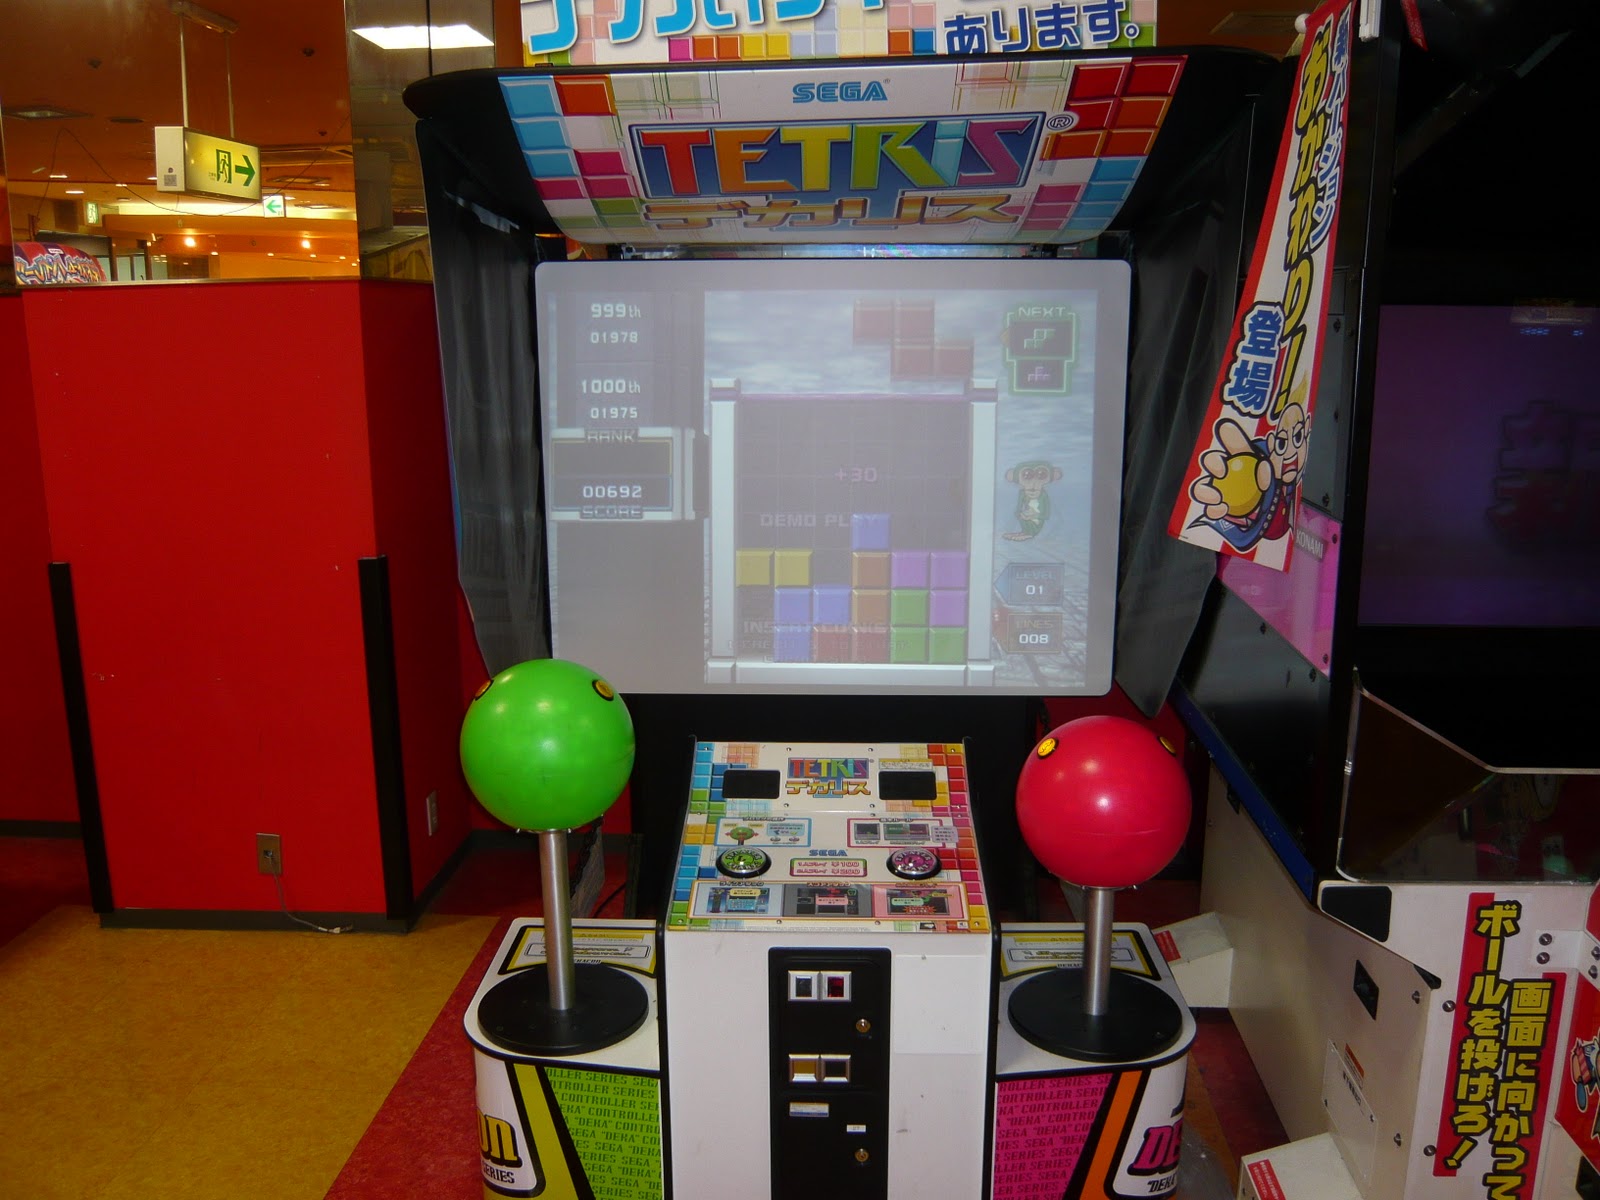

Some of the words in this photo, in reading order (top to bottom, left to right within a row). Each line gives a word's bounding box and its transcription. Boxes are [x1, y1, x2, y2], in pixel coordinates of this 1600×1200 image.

[943, 0, 1140, 53] あります。
[792, 80, 887, 103] SEGA
[640, 117, 1036, 196] TETRIS
[641, 194, 1019, 231] デカリス
[590, 303, 641, 318] 999th
[1018, 306, 1066, 317] NEXT
[590, 331, 639, 344] 01978
[1225, 305, 1282, 414] 登場
[581, 379, 641, 394] 1000th
[590, 407, 638, 419] 01975
[587, 430, 635, 442] RANK
[582, 485, 642, 498] 00692
[581, 505, 642, 518] SCORE
[759, 513, 816, 528] DEMO
[1296, 528, 1324, 560] KONAMI
[1015, 570, 1056, 580] LEVEL
[1025, 584, 1044, 595] 01
[1015, 619, 1053, 629] LINES
[1018, 633, 1049, 644] 008
[788, 757, 869, 779] TETRIS
[785, 780, 871, 796] デカリス
[808, 849, 848, 857] SEGA
[1483, 980, 1553, 1200] 画面に向かって
